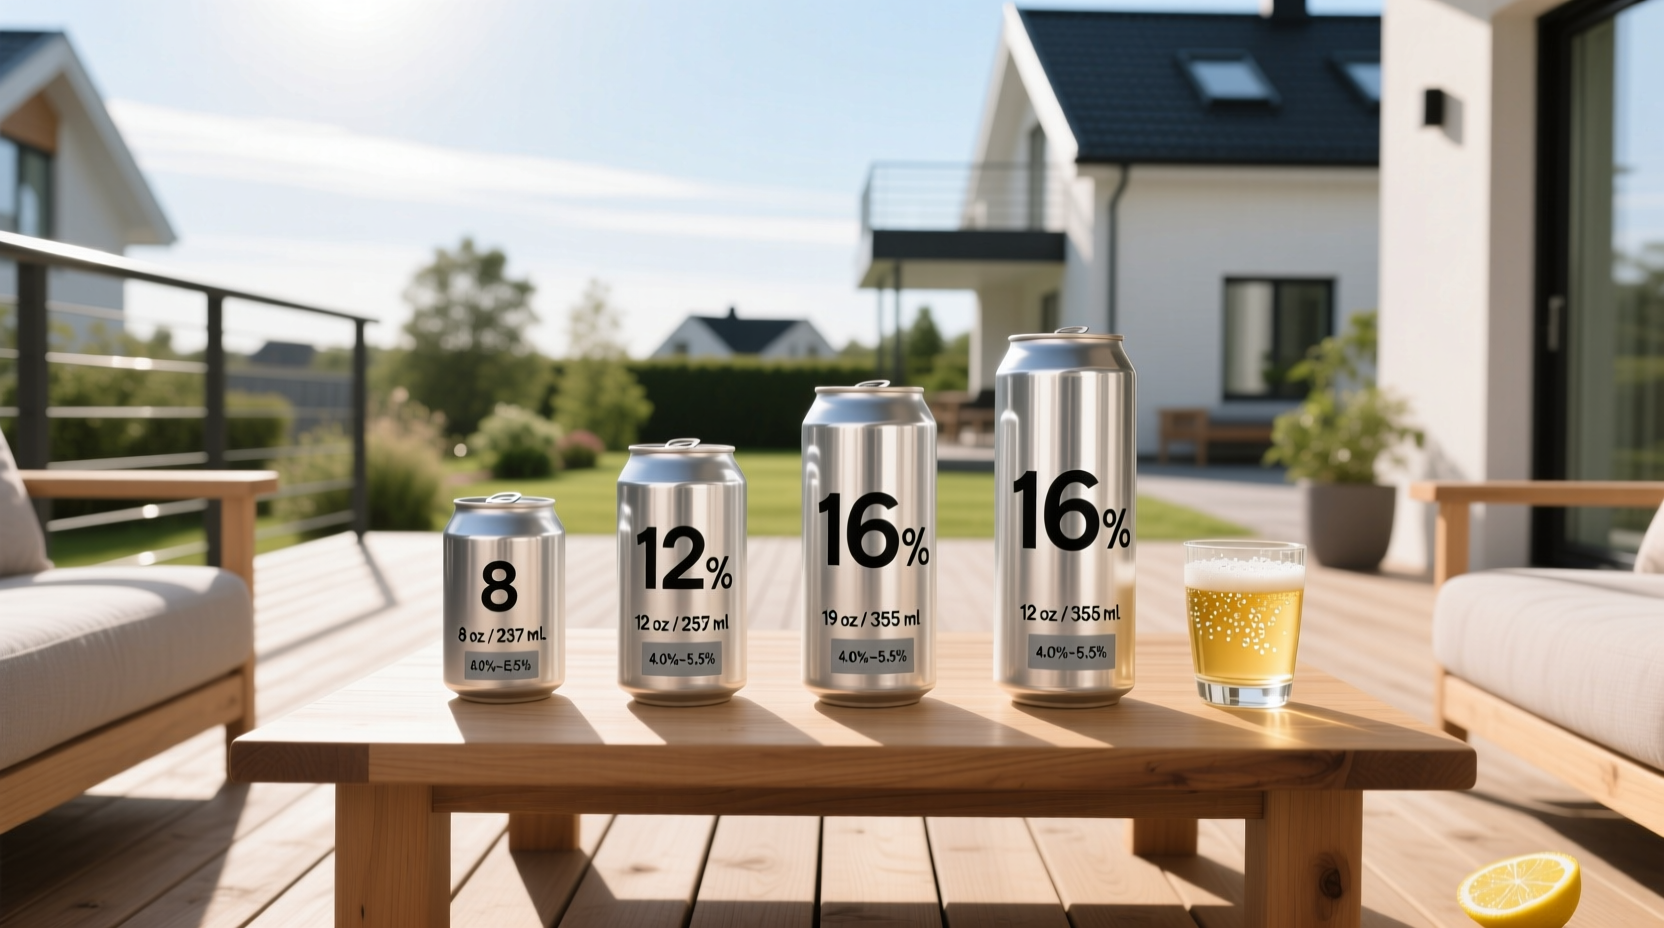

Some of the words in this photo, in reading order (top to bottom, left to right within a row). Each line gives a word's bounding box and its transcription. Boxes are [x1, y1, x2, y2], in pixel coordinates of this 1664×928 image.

[1013, 469, 1131, 552] 16%
[818, 491, 930, 569] 16%
[636, 525, 733, 590] 12%
[481, 560, 518, 613] 8
[634, 614, 650, 631] 12
[652, 620, 670, 632] oz
[672, 616, 679, 632] /
[681, 615, 710, 632] 257
[713, 613, 729, 631] ml
[822, 609, 838, 626] 19
[840, 615, 859, 627] oz
[860, 611, 867, 628] /
[870, 610, 900, 627] 355
[904, 609, 921, 627] ml
[1020, 604, 1037, 621] 12
[1039, 609, 1058, 622] oz
[1061, 605, 1068, 623] /
[458, 626, 467, 642] 8
[469, 631, 486, 643] oz
[487, 628, 494, 644] /
[496, 627, 525, 643] 237
